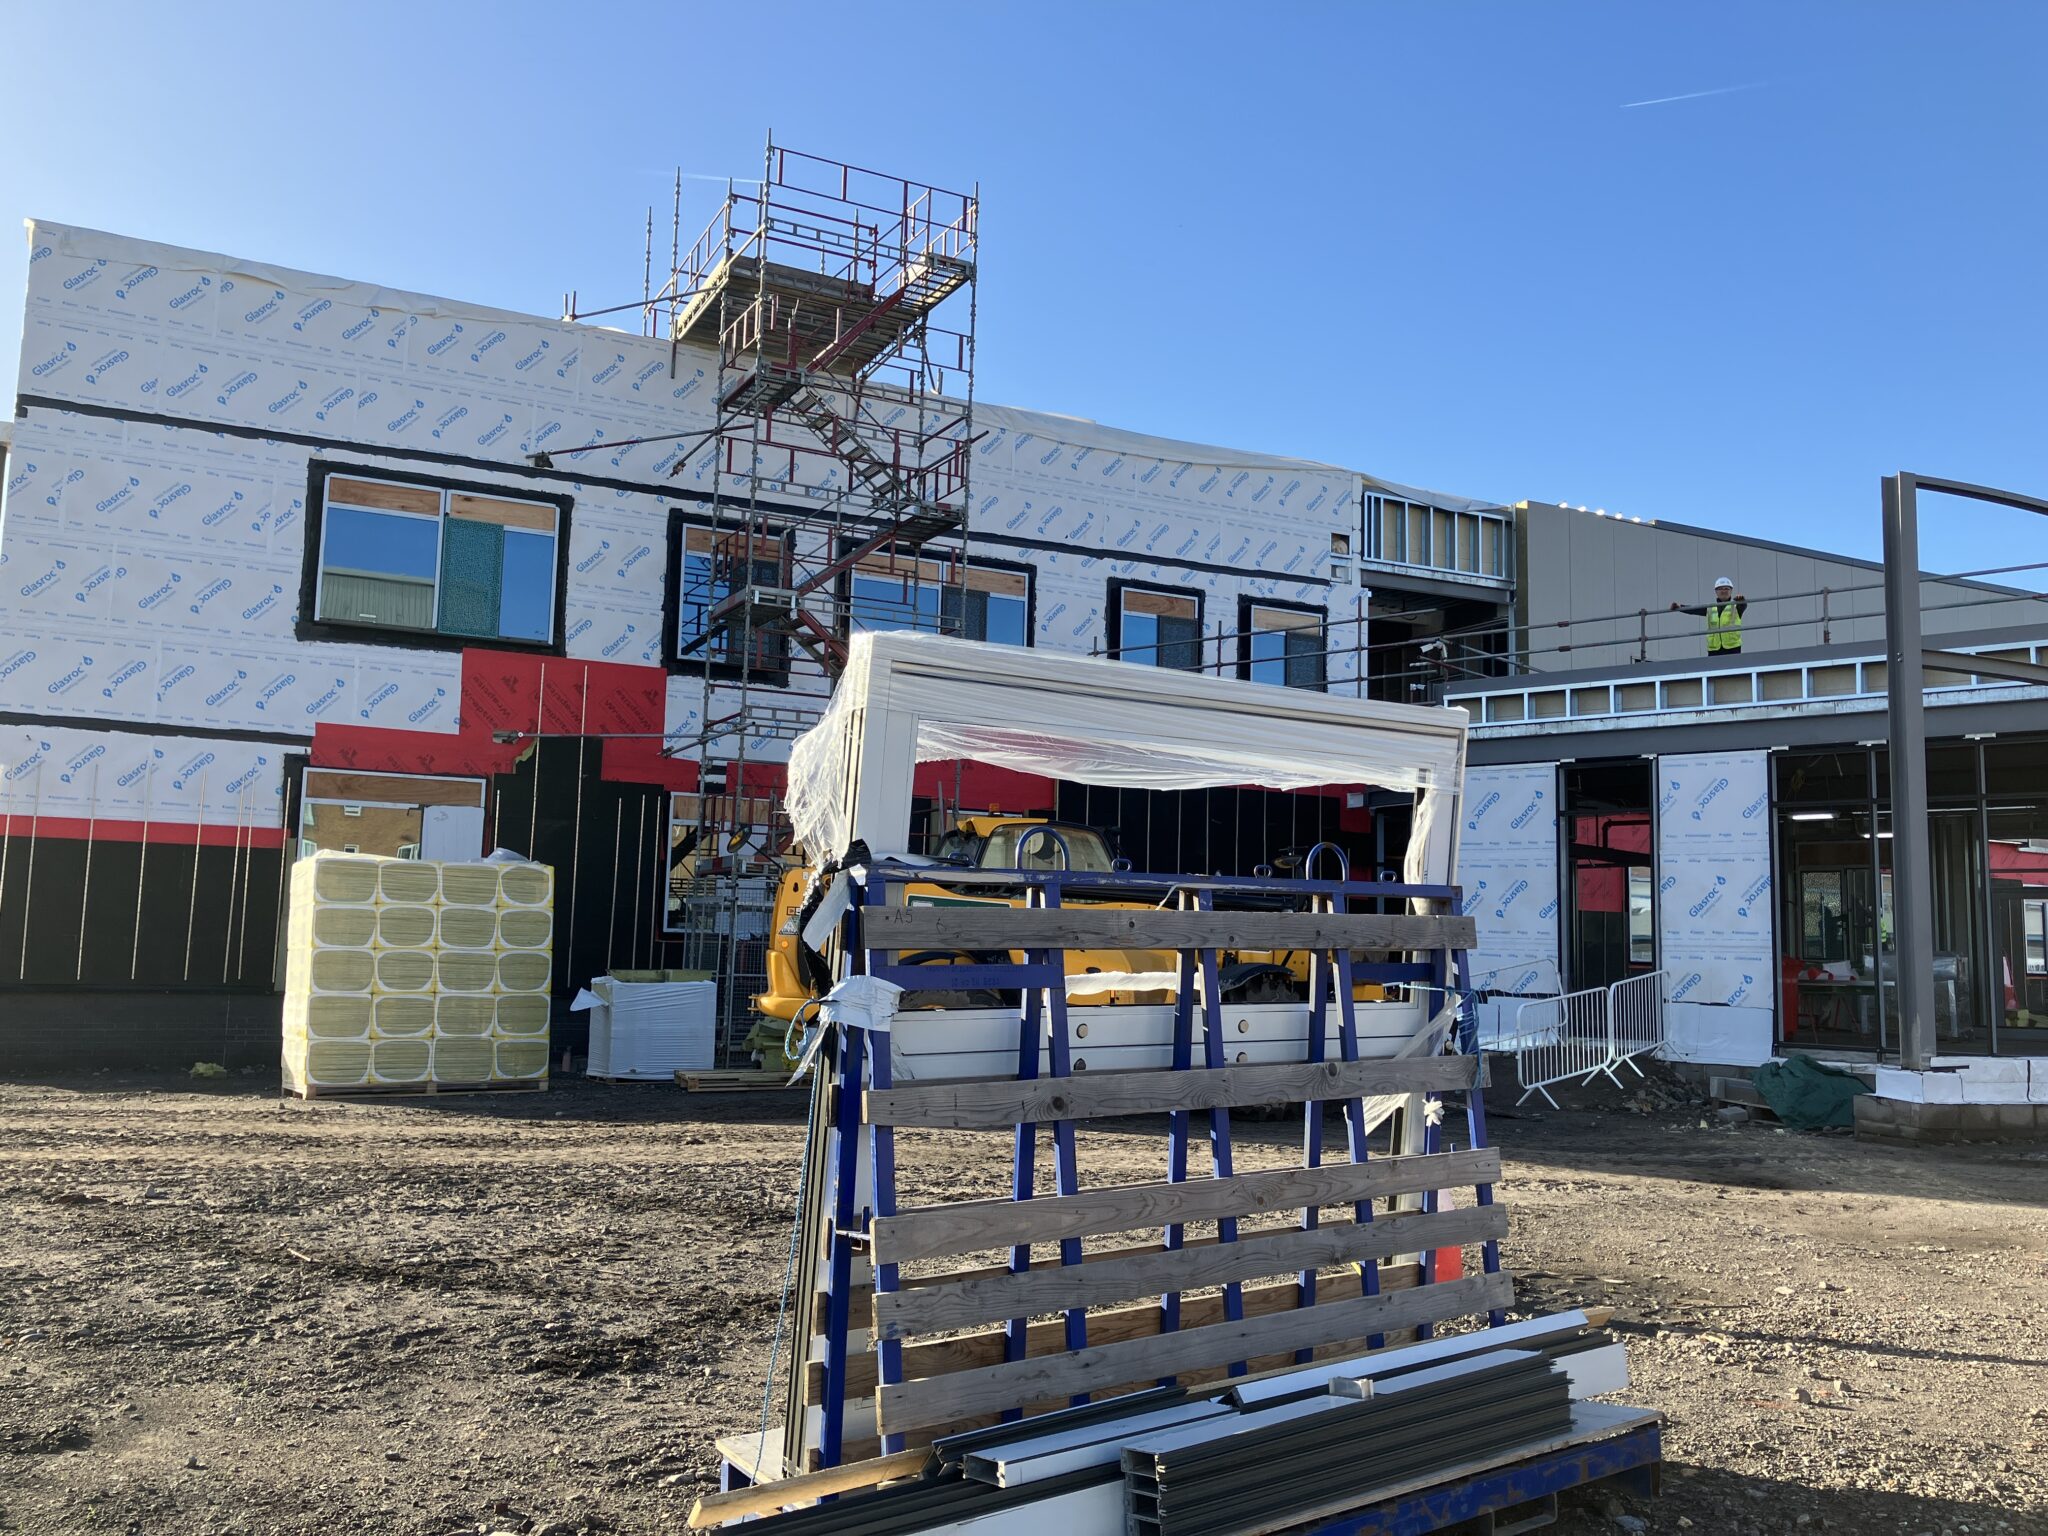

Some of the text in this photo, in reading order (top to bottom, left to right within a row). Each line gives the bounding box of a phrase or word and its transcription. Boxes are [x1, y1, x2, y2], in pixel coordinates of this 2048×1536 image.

[30, 247, 52, 264] Glas
[63, 265, 98, 290] Glasroc
[124, 267, 158, 290] Glasroc
[169, 286, 202, 309] Glasroc
[245, 301, 277, 322] Glasroc
[301, 300, 332, 322] Glasroc
[342, 317, 372, 339] Glasroc
[427, 334, 456, 355] Glasroc
[478, 332, 506, 353] Glasroc
[32, 350, 68, 376] Glasroc
[94, 351, 129, 374] Glasroc
[515, 348, 543, 370] Glasroc
[592, 363, 619, 384] Glasroc
[639, 362, 664, 382] Glasroc
[166, 374, 200, 396] Glasroc
[225, 373, 257, 395] Glasroc
[673, 378, 698, 398] Glasroc
[268, 390, 300, 413] Glasroc
[324, 389, 354, 411] Glasroc
[358, 392, 378, 408] Glas
[387, 409, 417, 432] Glasroc
[439, 407, 468, 430] Glasroc
[478, 424, 506, 446] Glasroc
[981, 433, 1001, 454] Glasroc
[653, 451, 678, 473] Glasroc
[698, 451, 724, 472] Gasroc
[1041, 445, 1063, 465] Glasroc
[1102, 456, 1122, 476] Glasroc
[8, 473, 28, 490] sroc
[1141, 463, 1160, 483] Glasroc
[96, 486, 131, 512] Glasroc
[157, 484, 191, 507] Glasroc
[980, 497, 999, 515] Glasro
[202, 500, 235, 526] Glasroc
[274, 509, 294, 528] sroc
[1006, 509, 1027, 529] Glasroc
[1043, 506, 1062, 526] Glasroc
[1069, 519, 1089, 539] Glasroc
[1116, 525, 1137, 547] Glasroc
[1176, 535, 1195, 556] Glasroc
[576, 552, 603, 573] Glasroc
[623, 546, 650, 569] Glasroc
[20, 570, 57, 597] Glasroc
[200, 578, 232, 603] Glasroc
[138, 583, 172, 609] Glasroc
[242, 595, 274, 620] Glasroc
[1046, 604, 1066, 624] Glasroc
[1073, 617, 1092, 636] Glasroc
[602, 634, 628, 656] Glasroc
[48, 667, 84, 693] Glasroc
[112, 661, 147, 687] Glasroc
[161, 665, 195, 691] Glasroc
[206, 680, 239, 706] Glasroc
[264, 674, 295, 698] Glasroc
[368, 683, 399, 708] Glasroc
[306, 690, 337, 714] Glasroc
[408, 698, 438, 722] Glasroc
[665, 719, 691, 743] Gasroc
[70, 745, 106, 772] Glasroc
[182, 752, 215, 779] Glasroc
[1698, 778, 1728, 809] Glasroc
[1742, 792, 1768, 818] Glasro
[1474, 792, 1500, 820] Glasroc
[1511, 802, 1537, 829] Glasroc
[1502, 880, 1528, 907] Glasroc
[1660, 876, 1676, 894] Glas
[1745, 876, 1771, 905] lasroc
[1462, 890, 1480, 913] asroc
[1539, 899, 1557, 918] Glasr
[1689, 887, 1719, 917] Glasroc
[1515, 971, 1538, 994] Glasro
[1672, 973, 1701, 1001] Glasroc
[1728, 986, 1746, 1006] sroc
